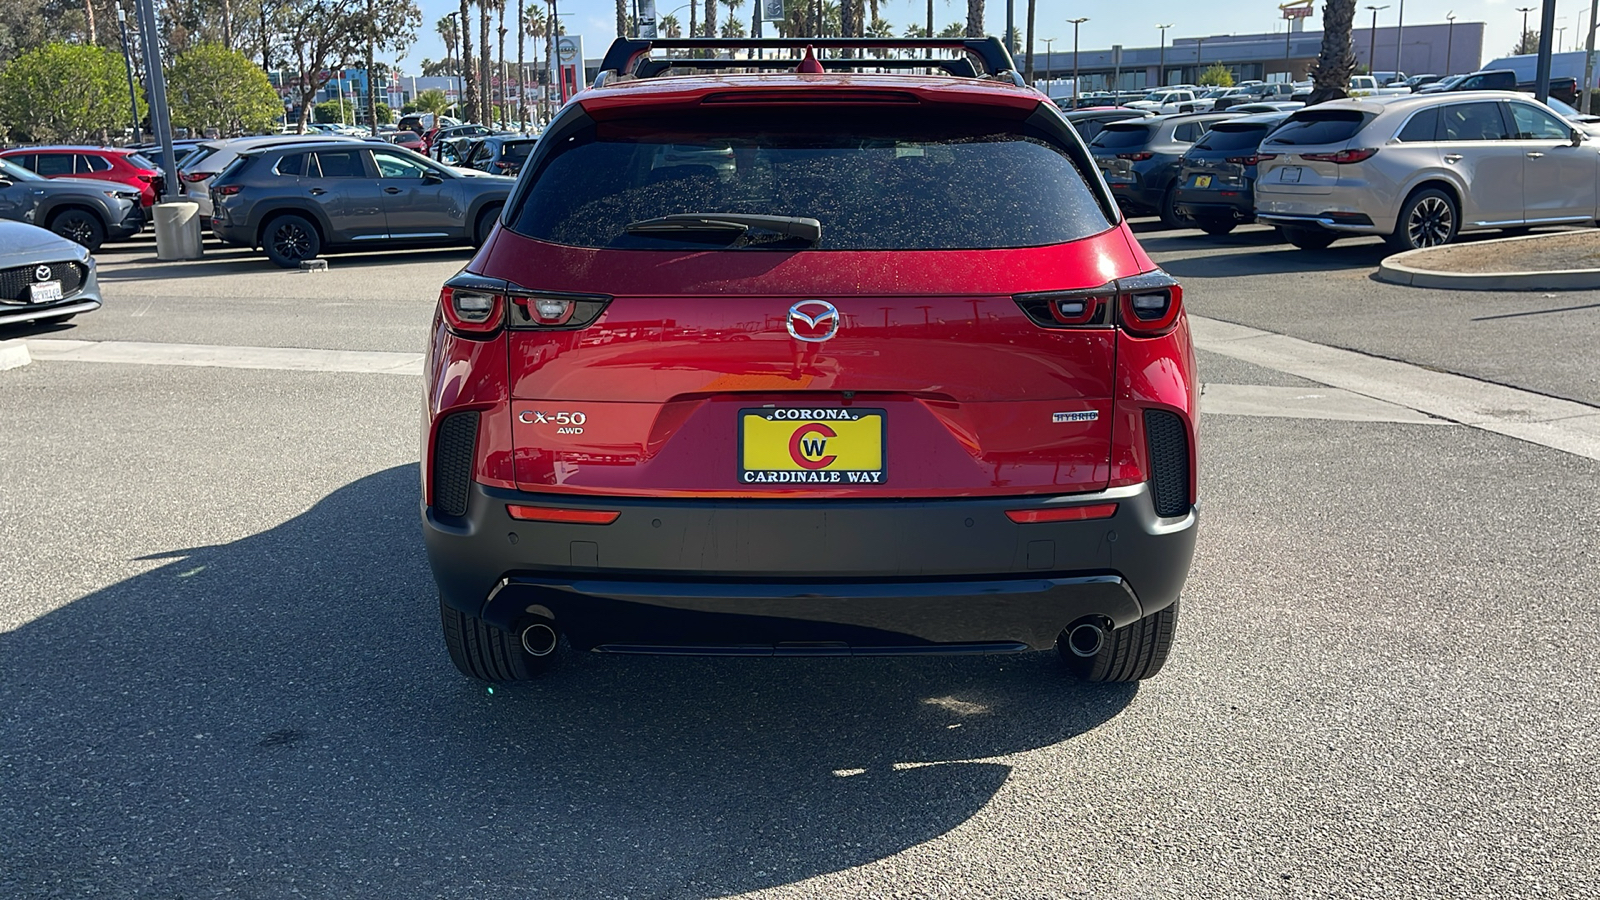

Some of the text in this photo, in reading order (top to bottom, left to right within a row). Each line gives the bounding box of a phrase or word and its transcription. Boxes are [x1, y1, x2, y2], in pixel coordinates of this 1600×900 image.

[518, 410, 587, 425] CX-50
[774, 409, 851, 420] CORONA
[1053, 410, 1099, 422] HYBRID
[556, 427, 584, 435] AWD
[743, 471, 882, 483] CARDINALE WAY
